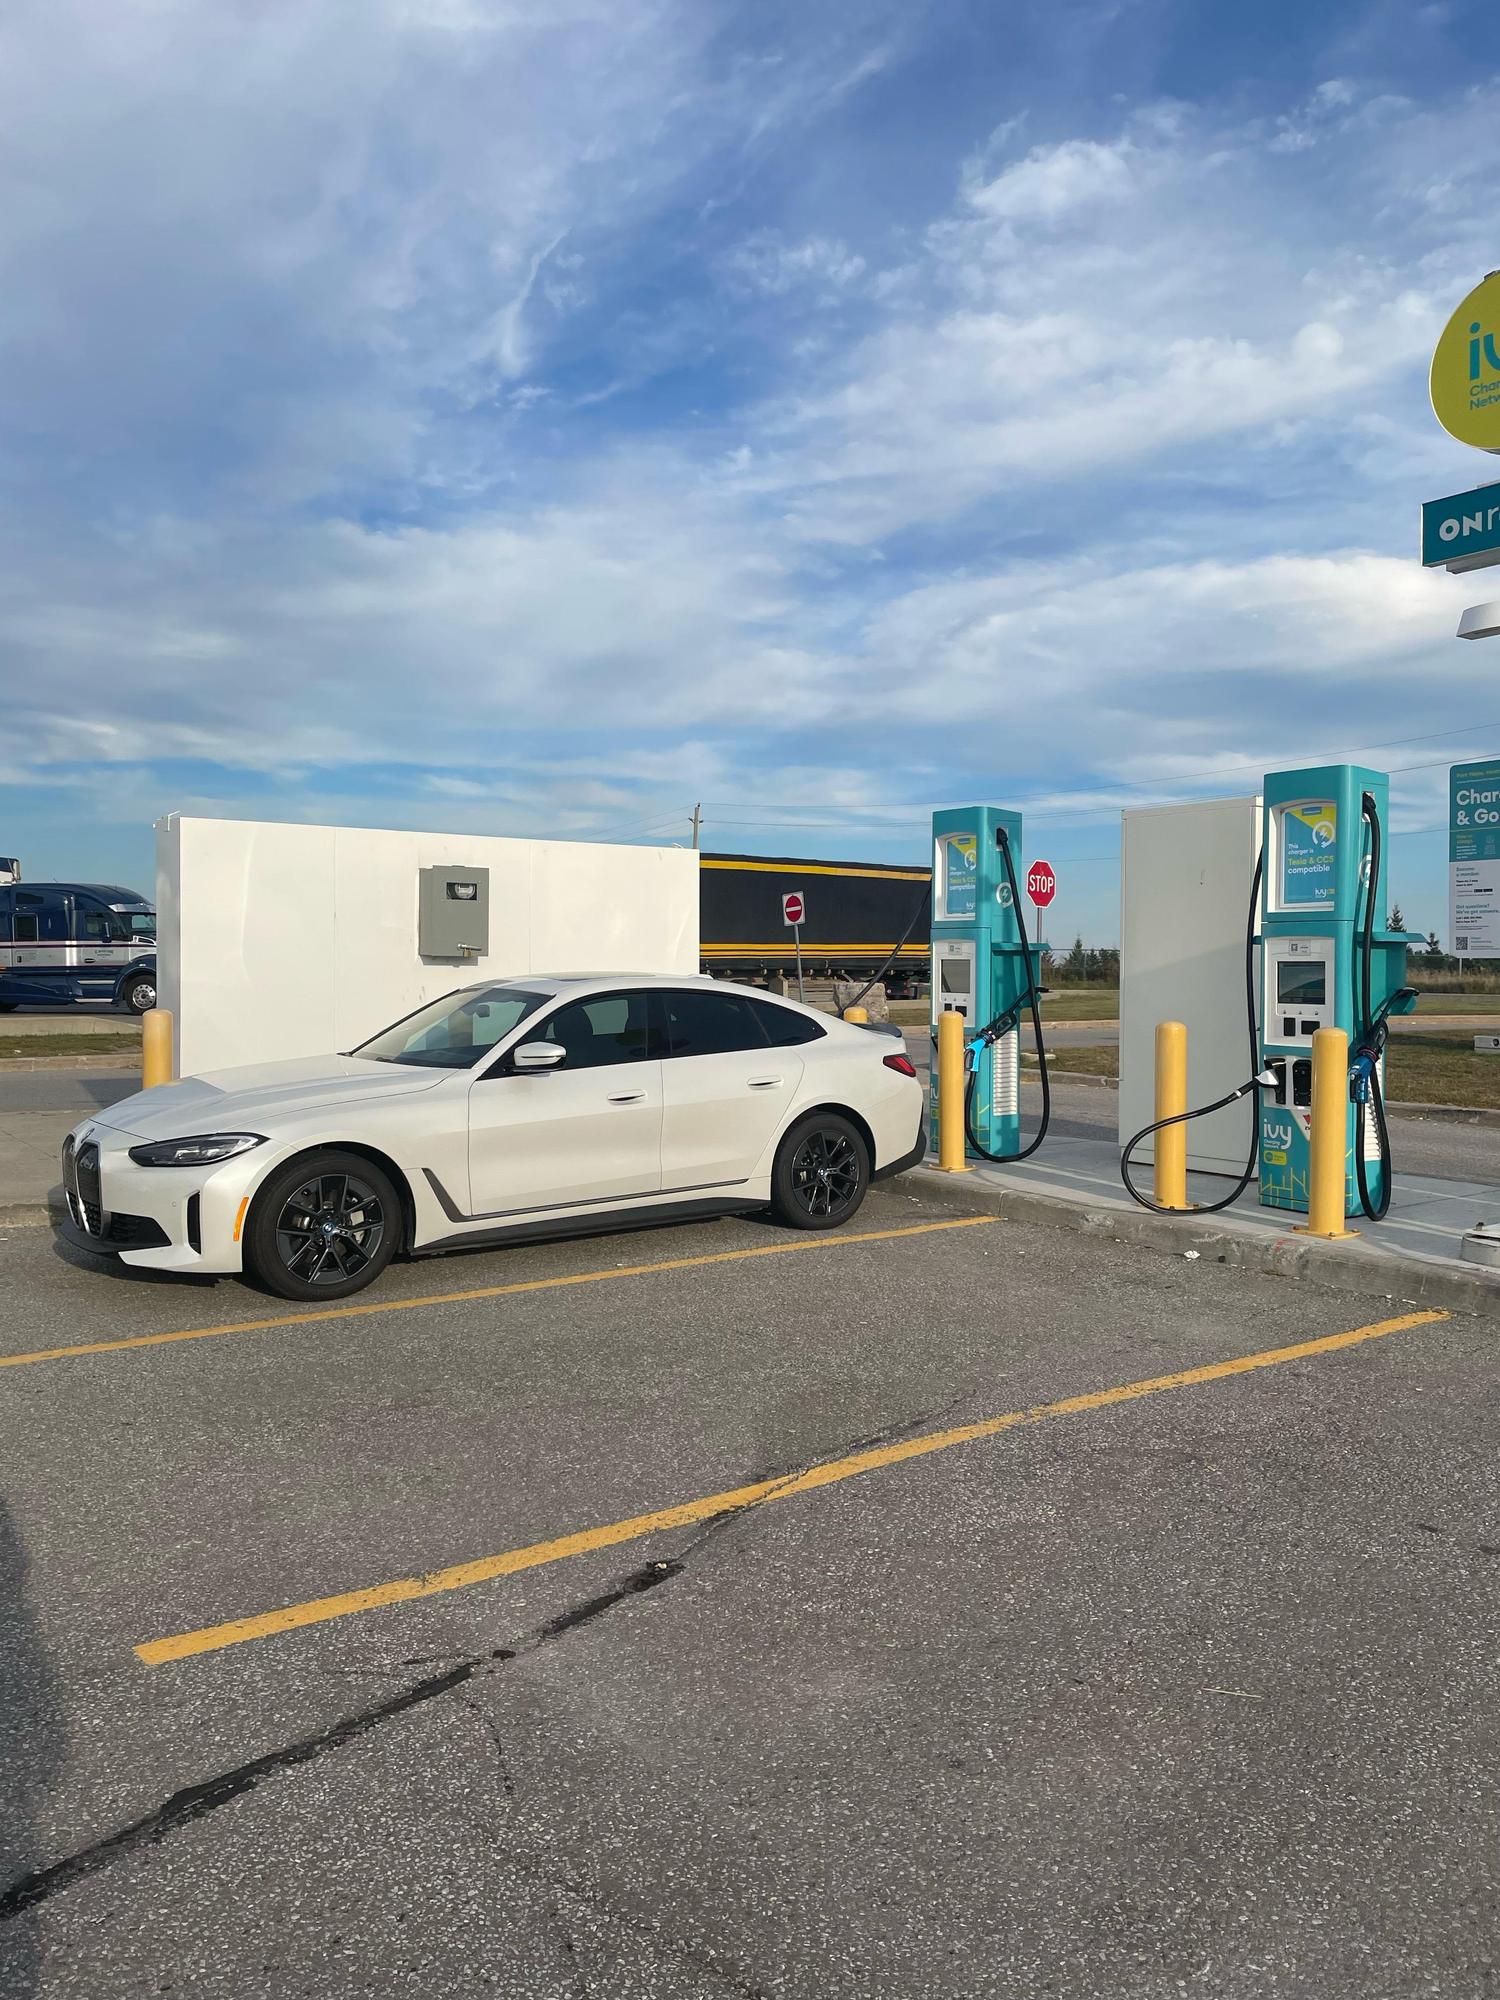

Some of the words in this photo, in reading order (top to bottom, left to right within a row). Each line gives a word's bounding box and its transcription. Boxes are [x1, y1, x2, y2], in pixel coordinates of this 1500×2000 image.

[1439, 507, 1500, 541] ONr
[1456, 789, 1500, 806] Char
[1456, 810, 1470, 826] &
[1474, 808, 1499, 824] Go
[1288, 864, 1330, 875] compatible
[1029, 875, 1054, 893] STOP
[1315, 888, 1327, 898] ivy
[1263, 1118, 1292, 1149] ivy
